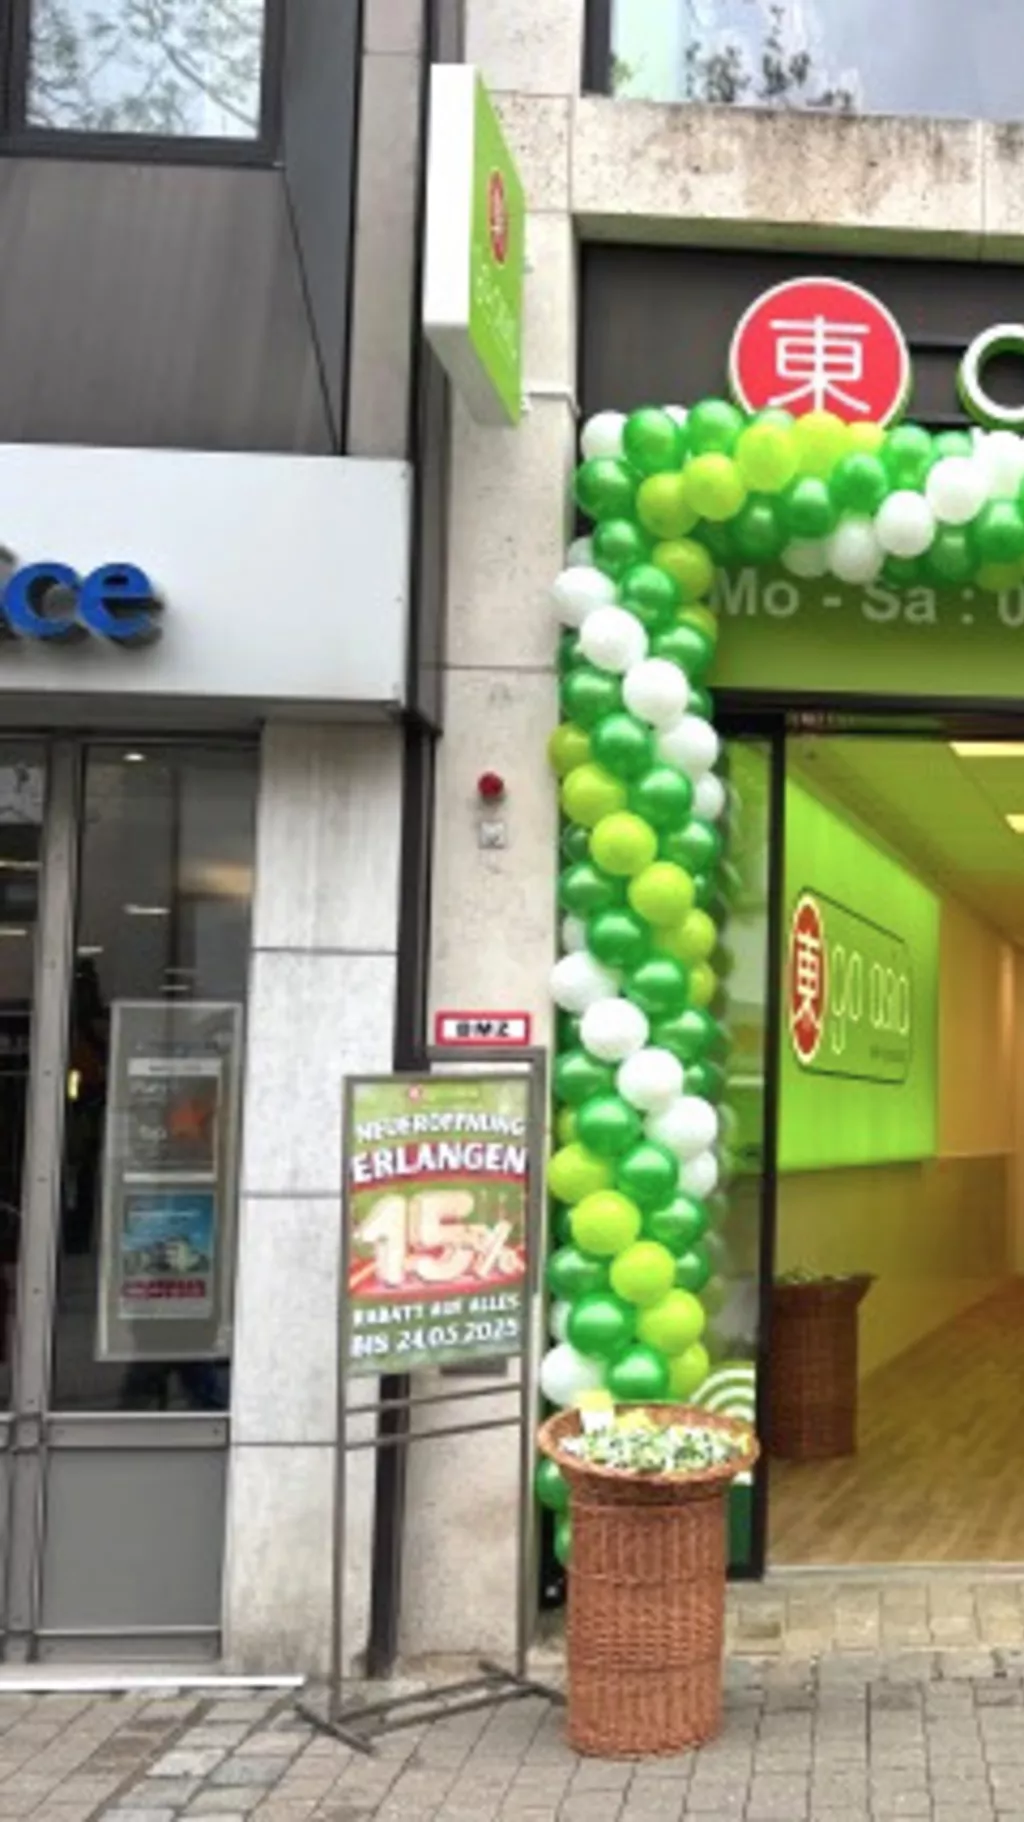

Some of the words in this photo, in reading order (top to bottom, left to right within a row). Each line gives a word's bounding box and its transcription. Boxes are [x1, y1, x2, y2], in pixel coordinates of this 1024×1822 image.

[767, 315, 871, 413] 東
[0, 562, 162, 645] ce
[711, 567, 799, 618] Mo
[861, 581, 937, 624] Sa
[352, 1142, 528, 1183] ERLANGEN
[353, 1189, 525, 1288] 15%
[468, 1292, 522, 1313] ALLES
[350, 1333, 389, 1359] BIS
